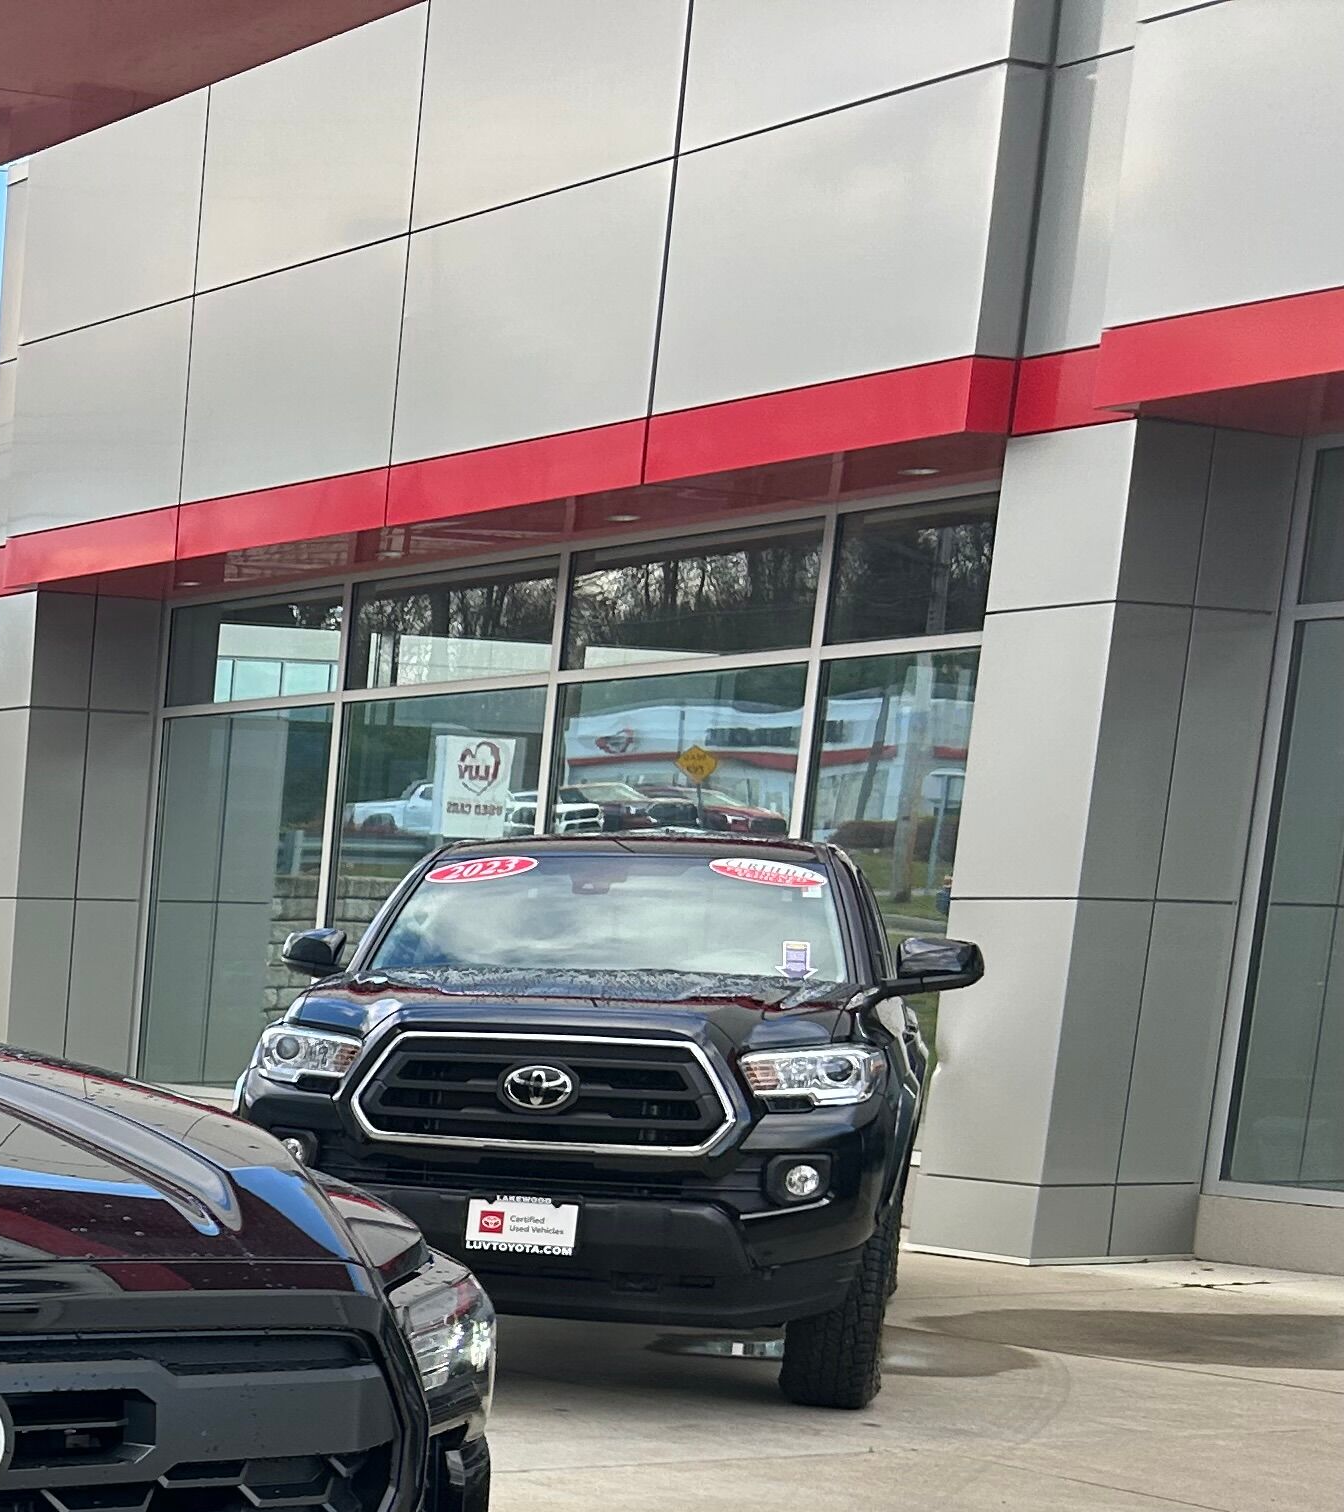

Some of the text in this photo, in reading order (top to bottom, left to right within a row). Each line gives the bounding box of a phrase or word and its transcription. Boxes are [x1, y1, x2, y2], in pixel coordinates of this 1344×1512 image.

[442, 859, 519, 880] 2023
[496, 1194, 552, 1204] LAKEWOOD
[509, 1215, 546, 1225] Certified
[509, 1225, 564, 1235] Used Vehicles
[465, 1240, 572, 1256] LUVTOYOTA.COM
